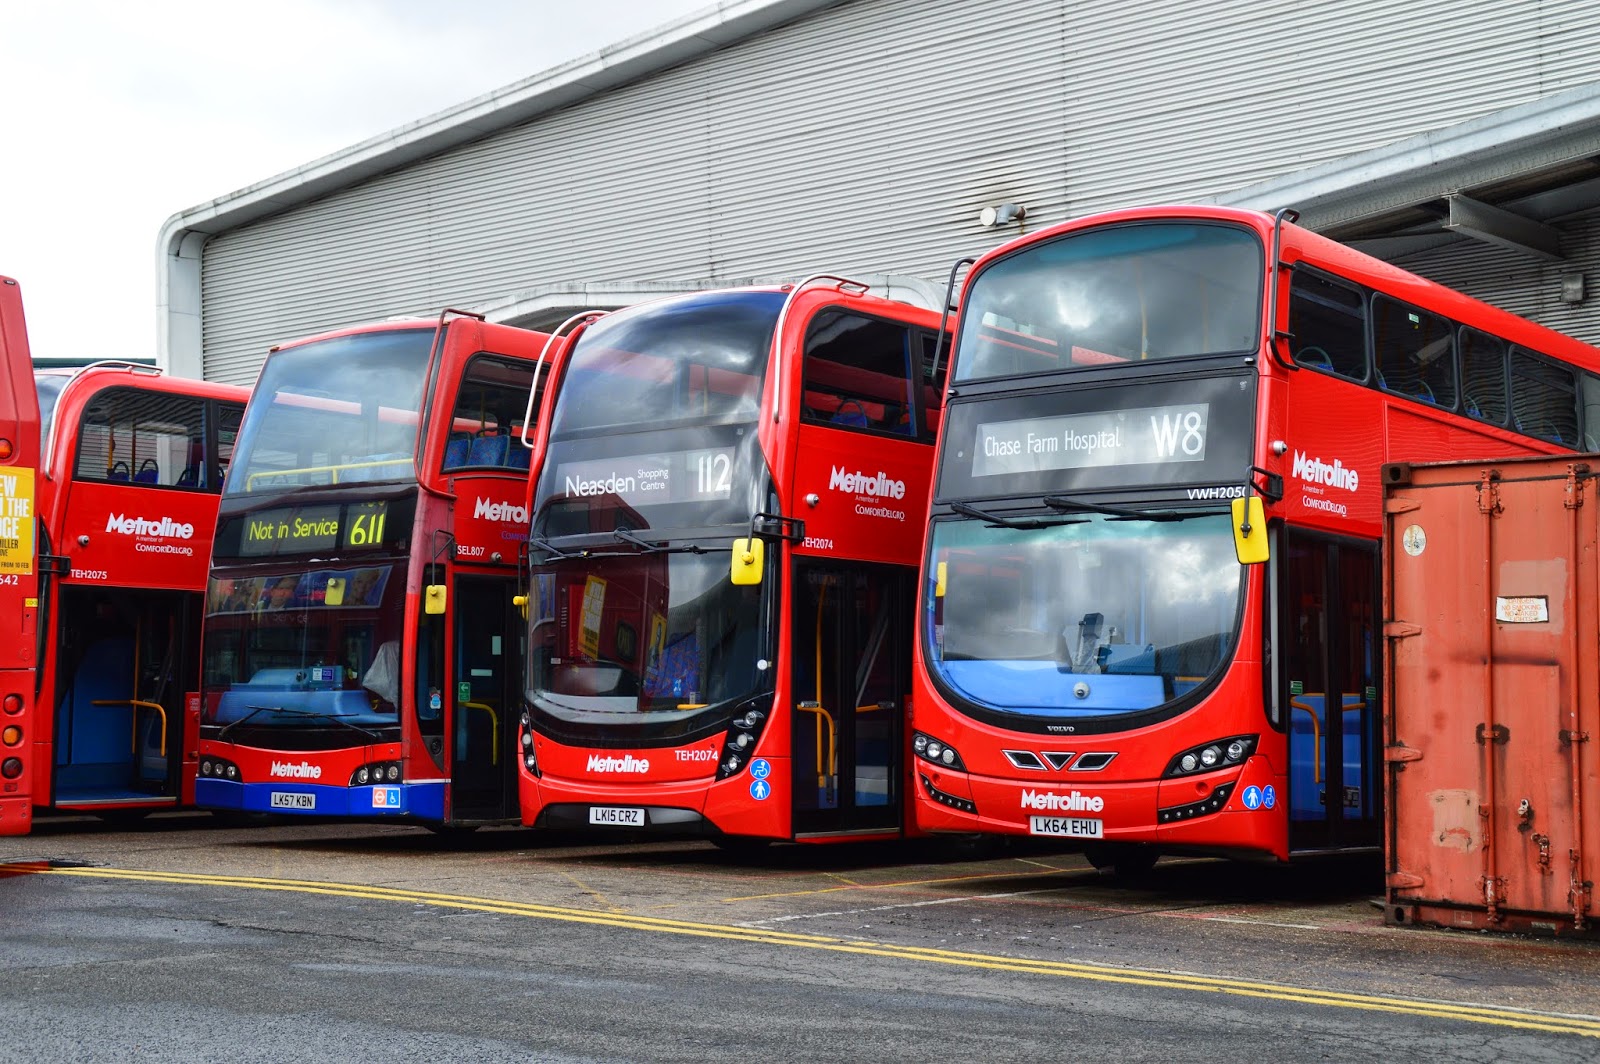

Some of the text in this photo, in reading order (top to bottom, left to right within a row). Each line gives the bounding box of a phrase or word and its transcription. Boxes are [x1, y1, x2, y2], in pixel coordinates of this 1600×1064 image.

[985, 426, 1121, 457] Chase Farm Hospital
[1150, 411, 1203, 457] W8
[637, 469, 669, 480] Shopping
[698, 453, 731, 493] 112
[1292, 448, 1359, 492] Metroline
[565, 472, 635, 498] Neasden
[640, 481, 665, 491] Centre
[828, 464, 906, 500] Metroline
[6, 498, 30, 517] THE
[105, 512, 194, 539] Metroline
[249, 517, 338, 541] Not in Service
[350, 513, 385, 545] 611
[457, 544, 485, 557] SEL807
[70, 568, 108, 580] TEH2075
[586, 754, 650, 774] Metroline
[675, 750, 719, 761] TEH2074
[270, 760, 322, 779] Metroline
[274, 794, 313, 807] LK57 KBN
[1021, 789, 1104, 812] Metroline
[595, 809, 638, 822] LK15 CRZ
[1035, 818, 1097, 835] LK64 EHU
